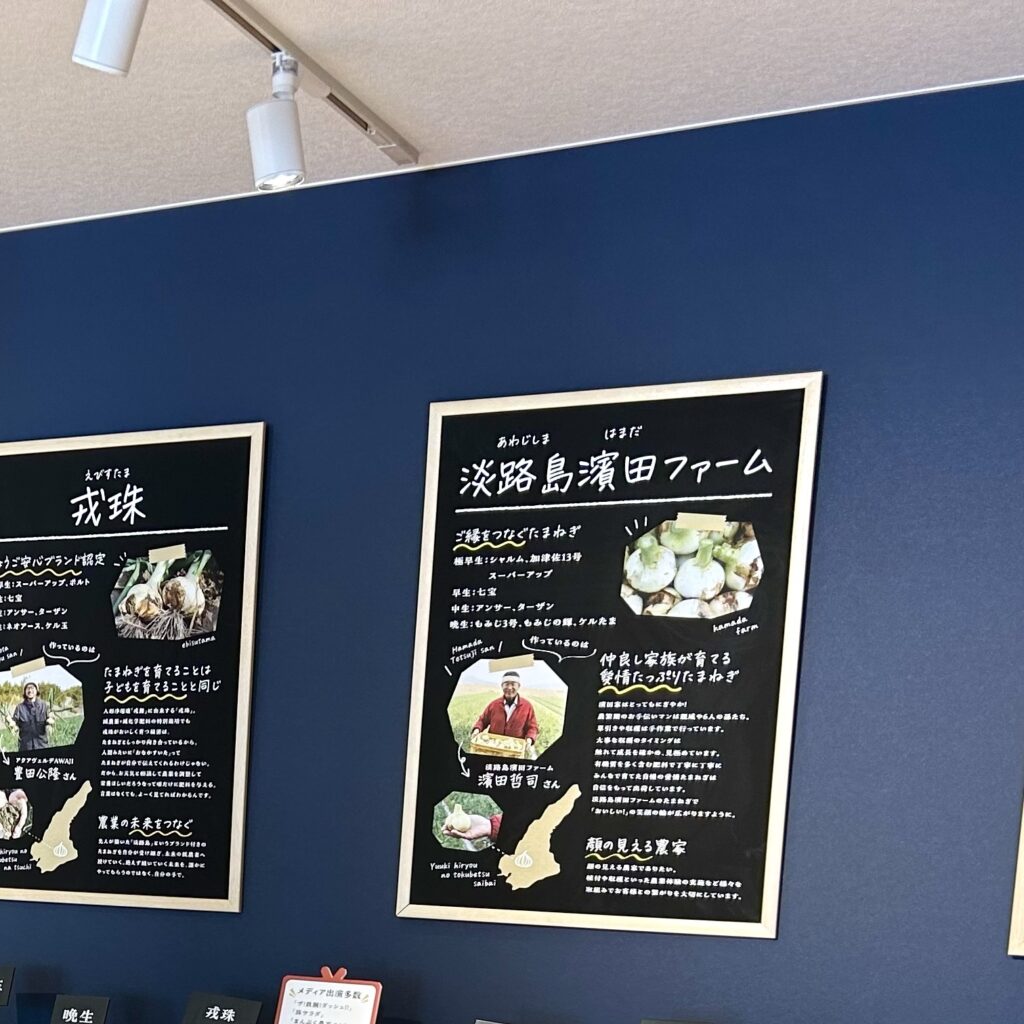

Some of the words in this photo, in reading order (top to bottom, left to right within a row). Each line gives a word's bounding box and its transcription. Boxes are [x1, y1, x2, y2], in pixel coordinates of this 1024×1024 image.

[496, 432, 551, 449] あわじしま
[604, 425, 643, 441] はまだ
[84, 467, 130, 481] えびすたま
[458, 448, 773, 498] 淡路島濱田ファーム
[70, 483, 146, 527] 戎珠
[455, 524, 582, 544] ご縁をつなぐたまねぎ
[488, 568, 553, 580] スーパーアップ
[712, 616, 748, 634] hamada
[735, 622, 759, 637] farm
[49, 641, 95, 653] 作っているのは
[451, 638, 483, 655] Hamada
[480, 645, 495, 654] san
[529, 634, 589, 649] 作っているのは
[599, 650, 731, 668] 仲良し家族が育てる
[104, 663, 211, 679] たまねぎを育てることは
[599, 668, 740, 686] 愛情たっぷりたまねぎ
[104, 679, 222, 694] 子どもを育てることと同じ
[98, 815, 193, 830] 農業の未来をつなぐ
[585, 836, 687, 856] 顔の見える農家
[297, 987, 362, 1000] メディア出演多数
[61, 1007, 94, 1024] 晩生
[205, 1005, 236, 1023] 戎珠
